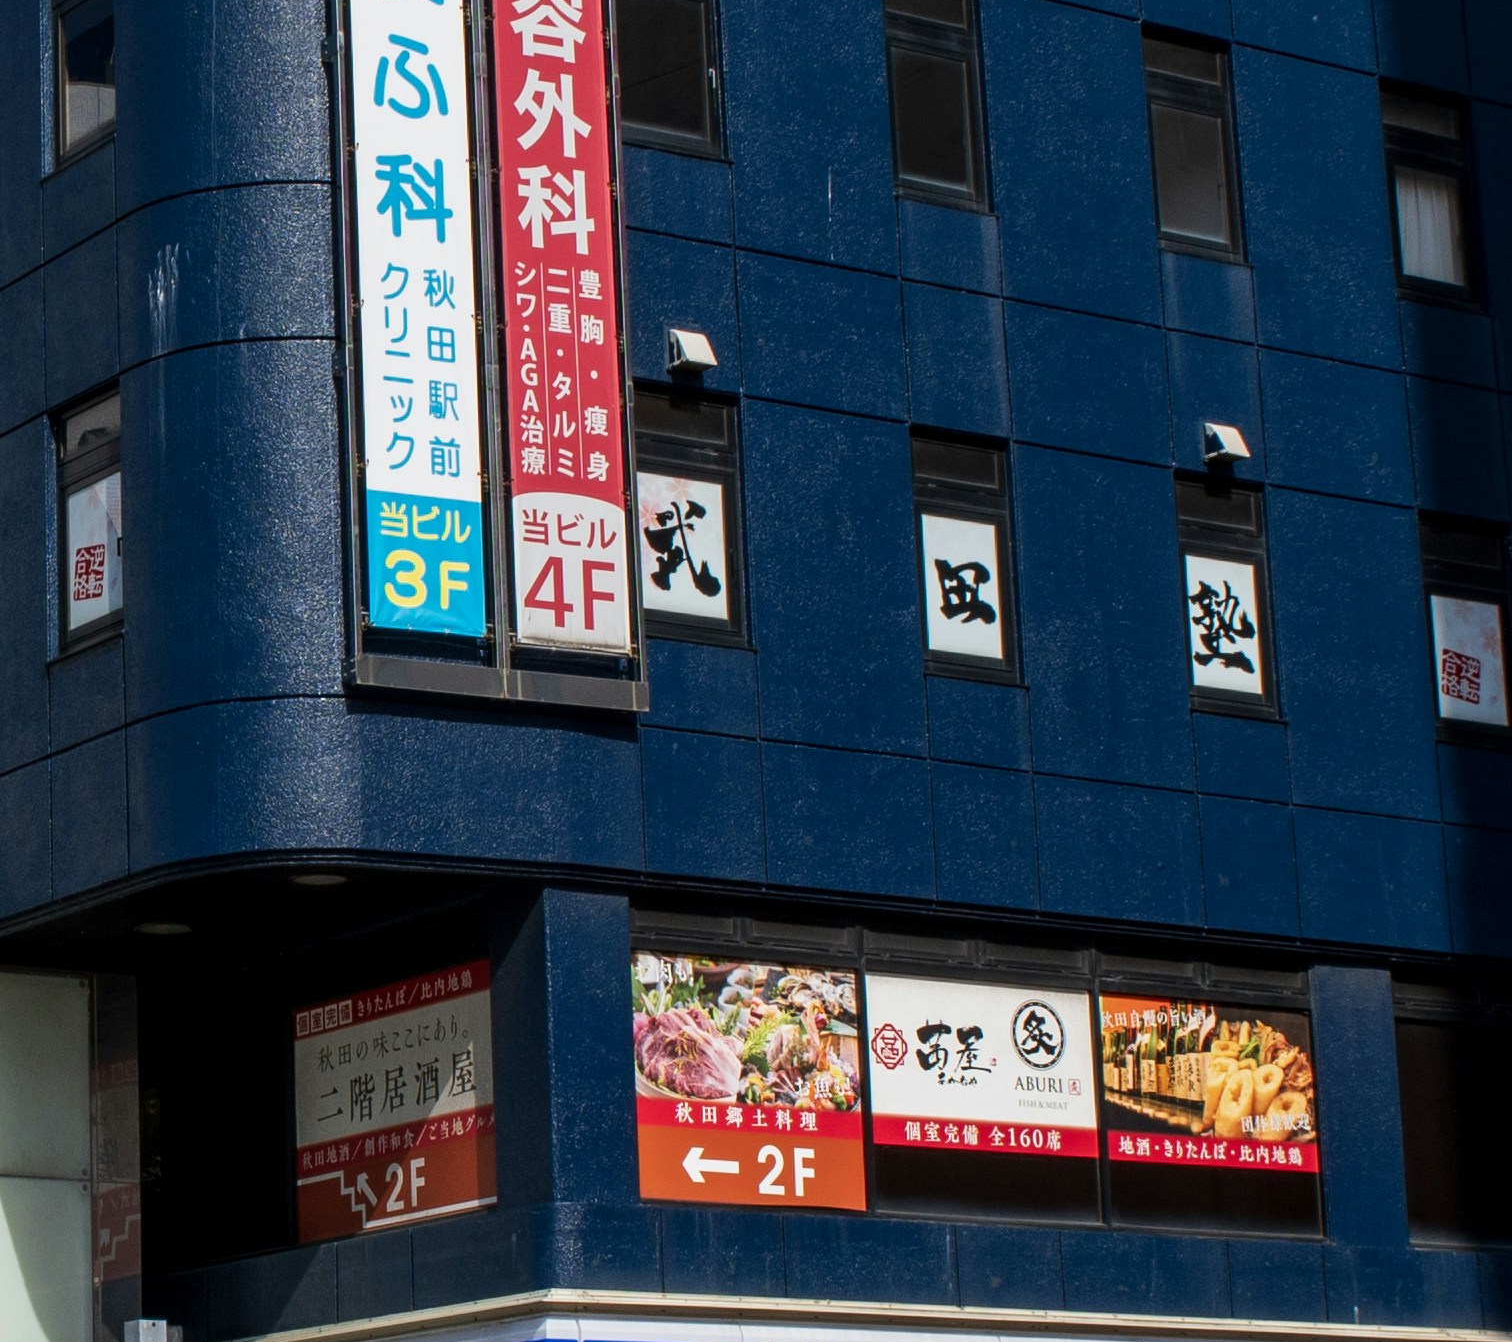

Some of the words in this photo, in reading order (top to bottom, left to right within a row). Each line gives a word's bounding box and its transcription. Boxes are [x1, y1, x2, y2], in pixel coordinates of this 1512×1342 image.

[380, 262, 415, 470] クリニック
[423, 269, 461, 478] 秋田駅前
[514, 261, 546, 476] シワ・AGA治療
[546, 267, 576, 478] 二重・タルミ
[578, 270, 610, 482] 豊胸・痩身
[380, 501, 471, 545] 当ビル
[522, 508, 617, 550] 当ビル
[384, 549, 471, 610] 3F
[524, 555, 616, 631] 4F
[645, 500, 722, 600] 武
[935, 558, 997, 626] 田
[1188, 579, 1256, 674] 塾
[297, 1000, 353, 1036] 個室完備
[317, 1014, 469, 1073] 秋田の味ここにあり。
[317, 1048, 477, 1122] 二階居酒屋
[1014, 1075, 1064, 1094] ABURI
[675, 1101, 819, 1132] 秋田郷土料理
[904, 1120, 979, 1146] 個室完備
[989, 1124, 1062, 1151] 全160席
[757, 1144, 815, 1196] 2F
[1118, 1136, 1303, 1166] 地酒・きりたんぽ・比内地鶏
[385, 1157, 425, 1212] 2F
